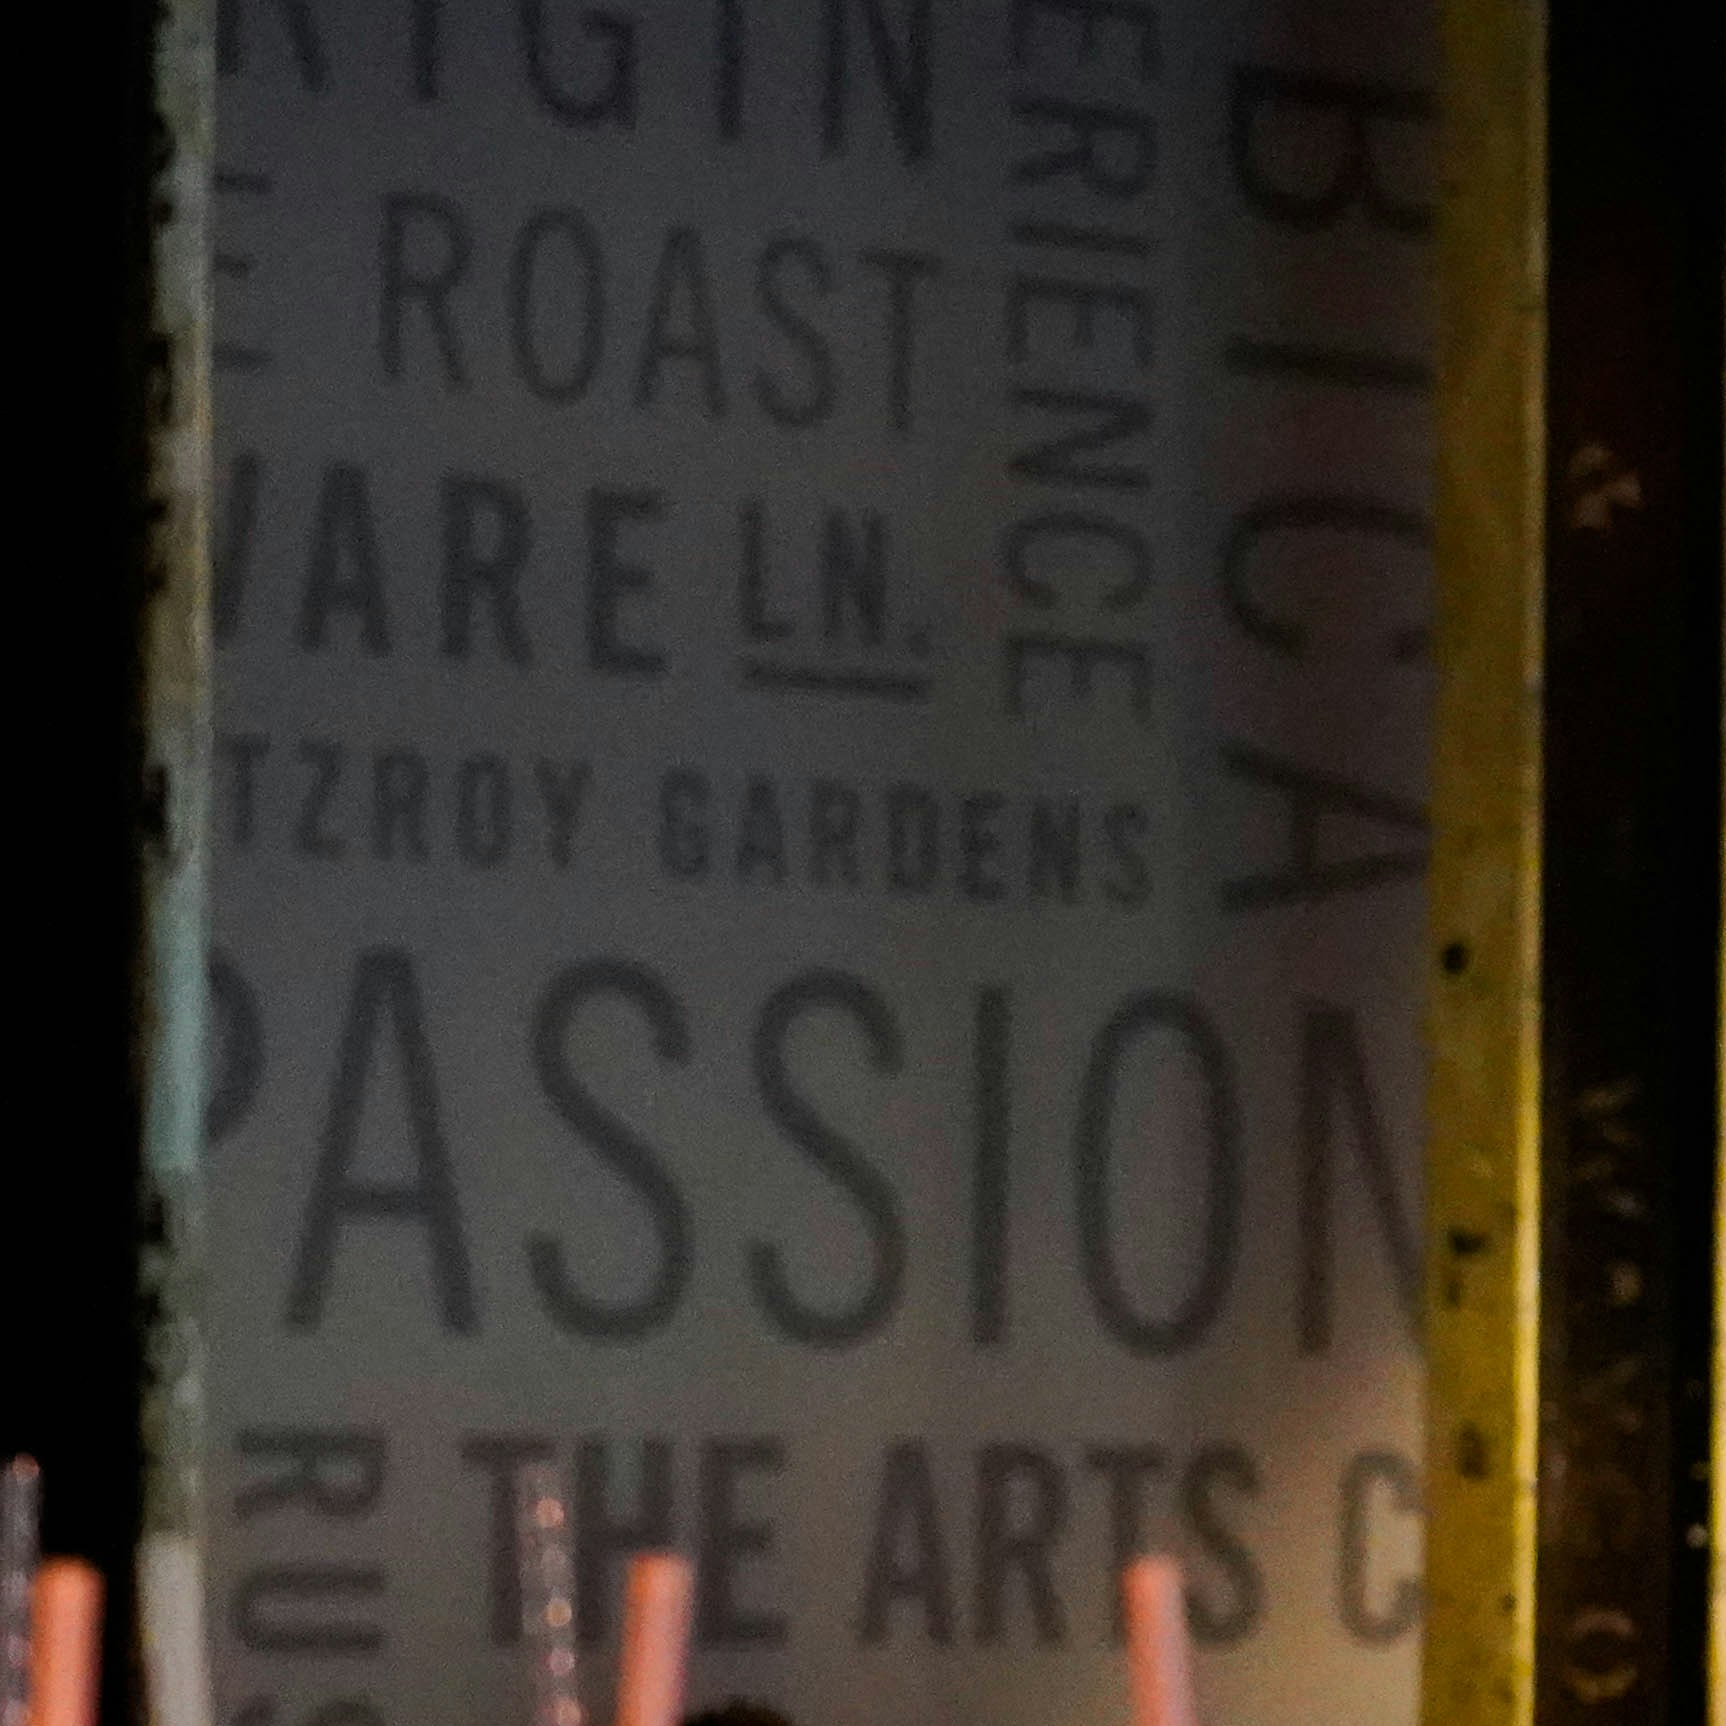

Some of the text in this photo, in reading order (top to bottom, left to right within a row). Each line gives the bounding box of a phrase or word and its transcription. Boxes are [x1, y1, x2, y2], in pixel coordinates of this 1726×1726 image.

[376, 190, 945, 435] ROAST
[656, 766, 1153, 910] GARDENS
[458, 1432, 788, 1648] THE
[858, 1435, 1265, 1648] ARTS
